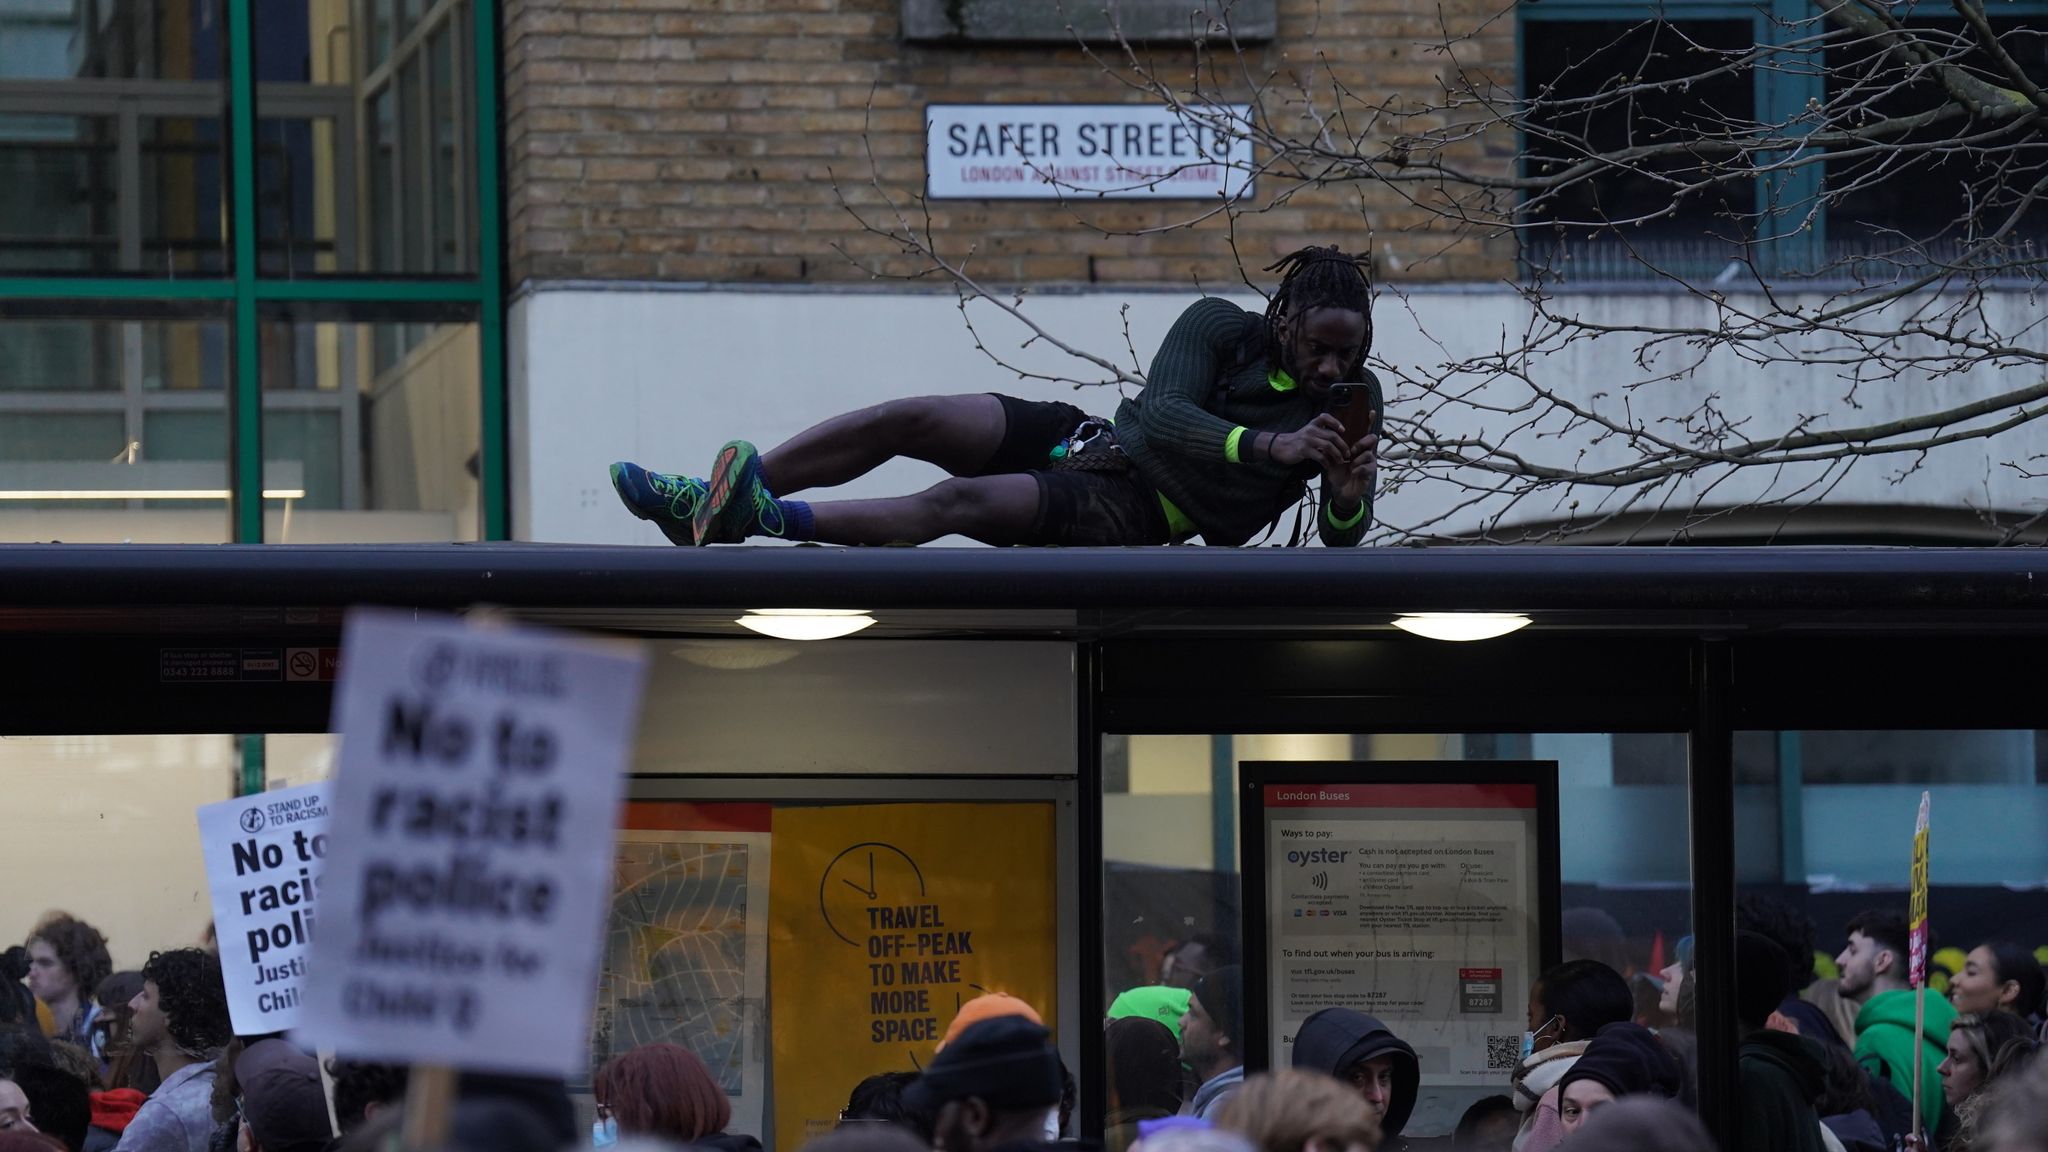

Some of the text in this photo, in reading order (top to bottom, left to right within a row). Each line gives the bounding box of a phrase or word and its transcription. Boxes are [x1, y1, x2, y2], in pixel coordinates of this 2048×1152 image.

[948, 123, 1231, 157] SAFER STREETS
[960, 166, 1025, 182] LONDON
[1032, 166, 1099, 182] AGAINST
[1105, 166, 1163, 182] STREET
[267, 796, 319, 815] STAND UP
[1277, 791, 1350, 801] London Buses
[269, 806, 329, 826] TO RACISM
[1281, 829, 1334, 838] Ways to pay:
[232, 830, 329, 876] No to
[1287, 847, 1348, 867] oyster
[1359, 848, 1494, 856] Cash is not accepted on London Buses
[867, 905, 944, 929] TRAVEL
[868, 931, 973, 958] OFF-PEAK
[1282, 949, 1435, 959] To find out when your bus is arriving:
[869, 960, 961, 986] TO MAKE
[870, 990, 930, 1014] MORE
[1469, 998, 1493, 1006] 87287
[871, 1018, 938, 1043] SPACE
